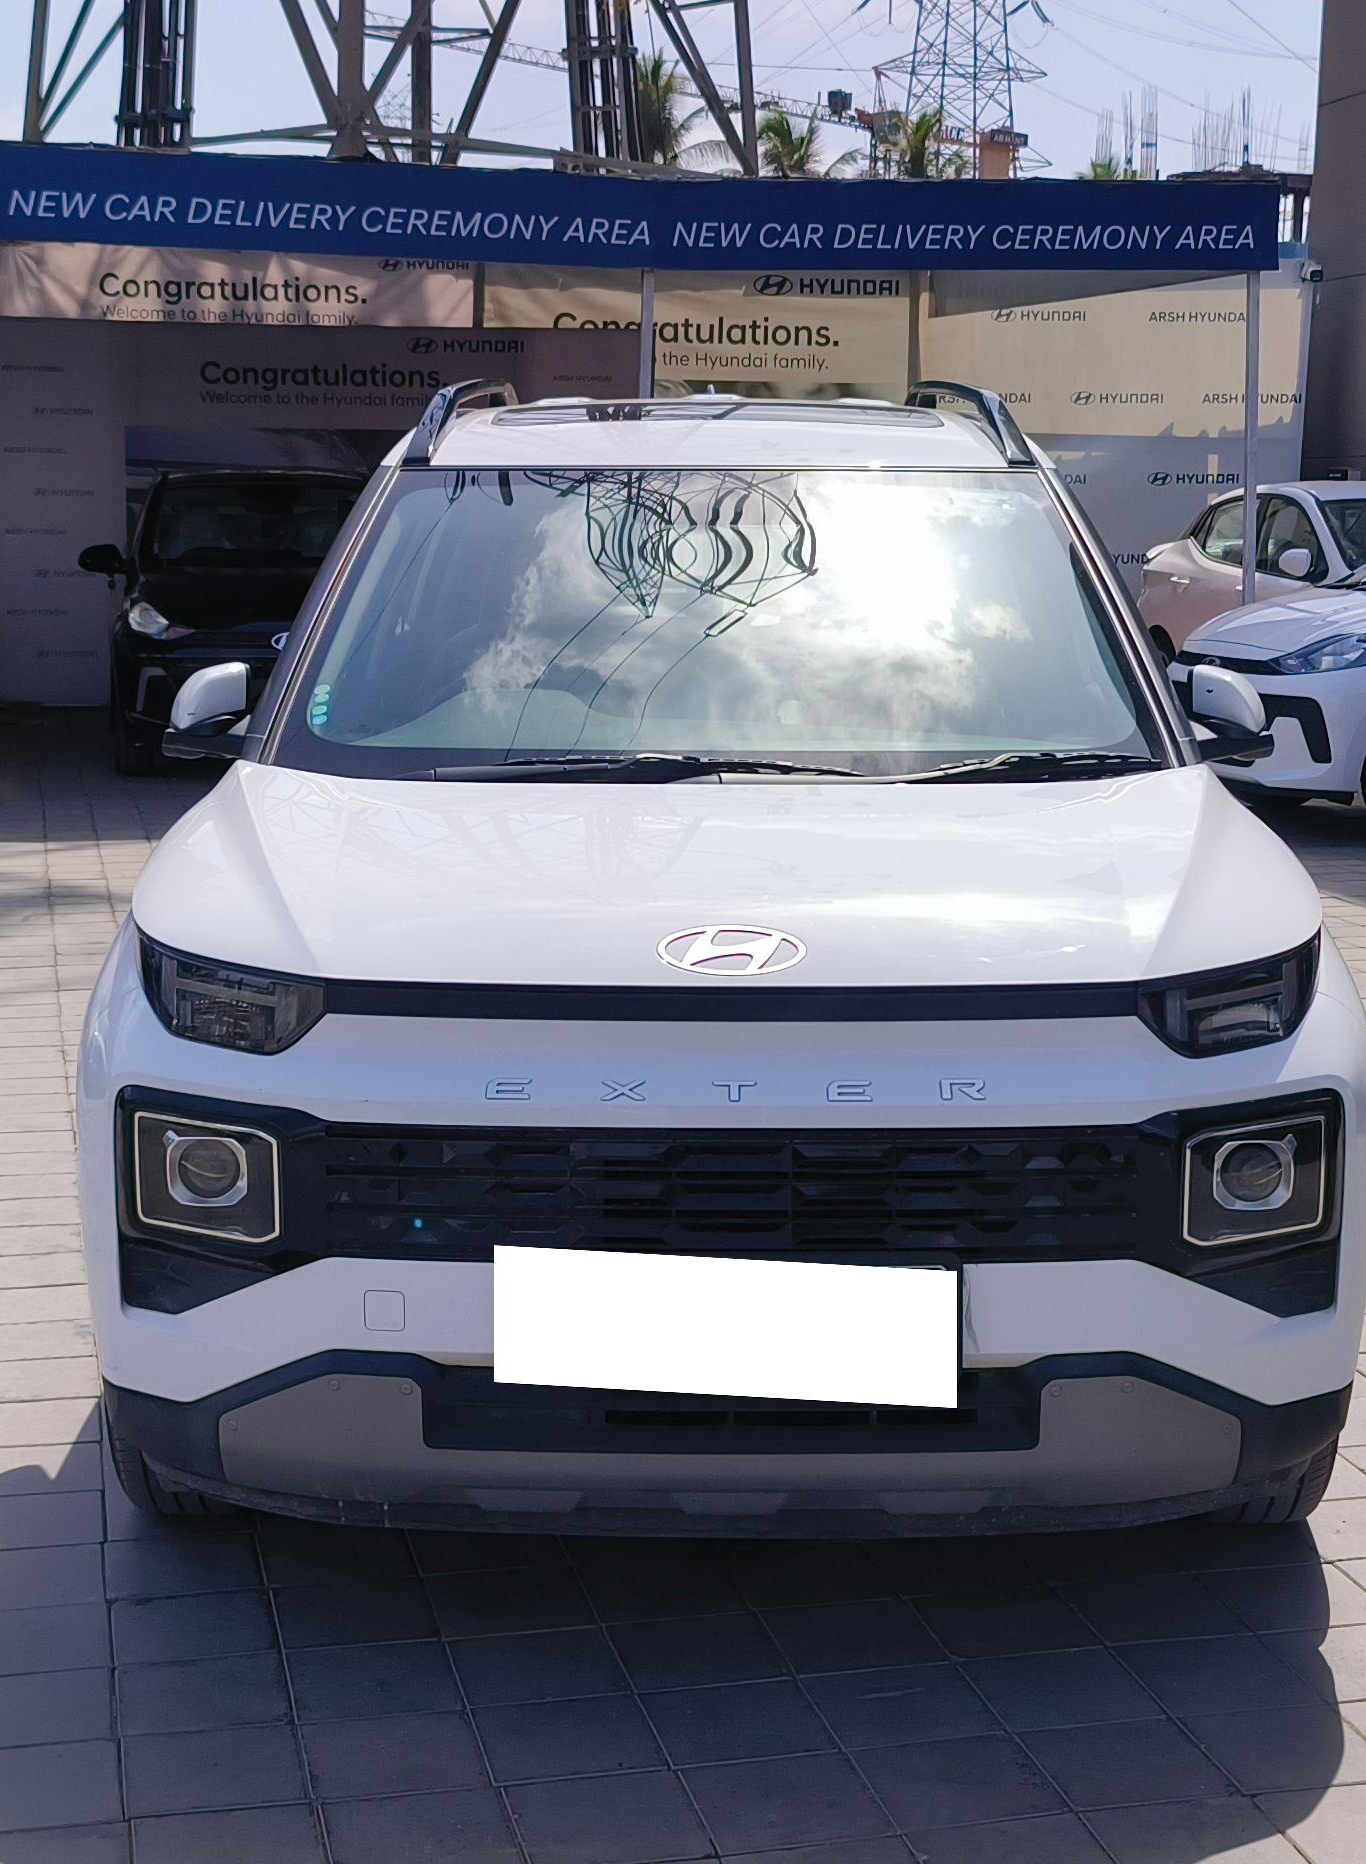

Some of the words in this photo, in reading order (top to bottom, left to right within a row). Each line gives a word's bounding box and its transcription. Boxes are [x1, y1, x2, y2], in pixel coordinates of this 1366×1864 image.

[8, 190, 97, 219] NEW
[104, 194, 177, 224] CAR
[188, 198, 356, 231] DELIVERY
[361, 206, 559, 241] CEREMONY
[563, 217, 651, 246] AREA
[672, 222, 752, 248] NEW
[759, 223, 825, 249] CAR
[834, 224, 986, 250] DELIVERY
[992, 225, 1172, 250] CEREMONY
[1175, 225, 1255, 250] AREA
[406, 259, 469, 271] HYUNDAI
[99, 272, 368, 305] Congratulations.
[799, 278, 900, 296] HYUNDAI
[100, 304, 176, 321] Welcome
[180, 307, 196, 321] to
[201, 307, 228, 323] the
[233, 308, 302, 325] Hyundai
[306, 309, 358, 326] family.
[1020, 310, 1087, 322] HYUNDAI
[1148, 311, 1186, 323] ARSH
[1188, 311, 1247, 323] HYUNDA
[443, 339, 525, 354] HYUNDAI
[662, 351, 690, 366] the
[695, 352, 768, 370] Hyundai
[773, 352, 829, 371] family.
[200, 361, 450, 391] Congratulations.
[1098, 393, 1164, 405] HYUNDAI
[1202, 393, 1238, 405] ARSH
[1176, 473, 1240, 485] HYUNDAI
[484, 1077, 987, 1103] EXTER
